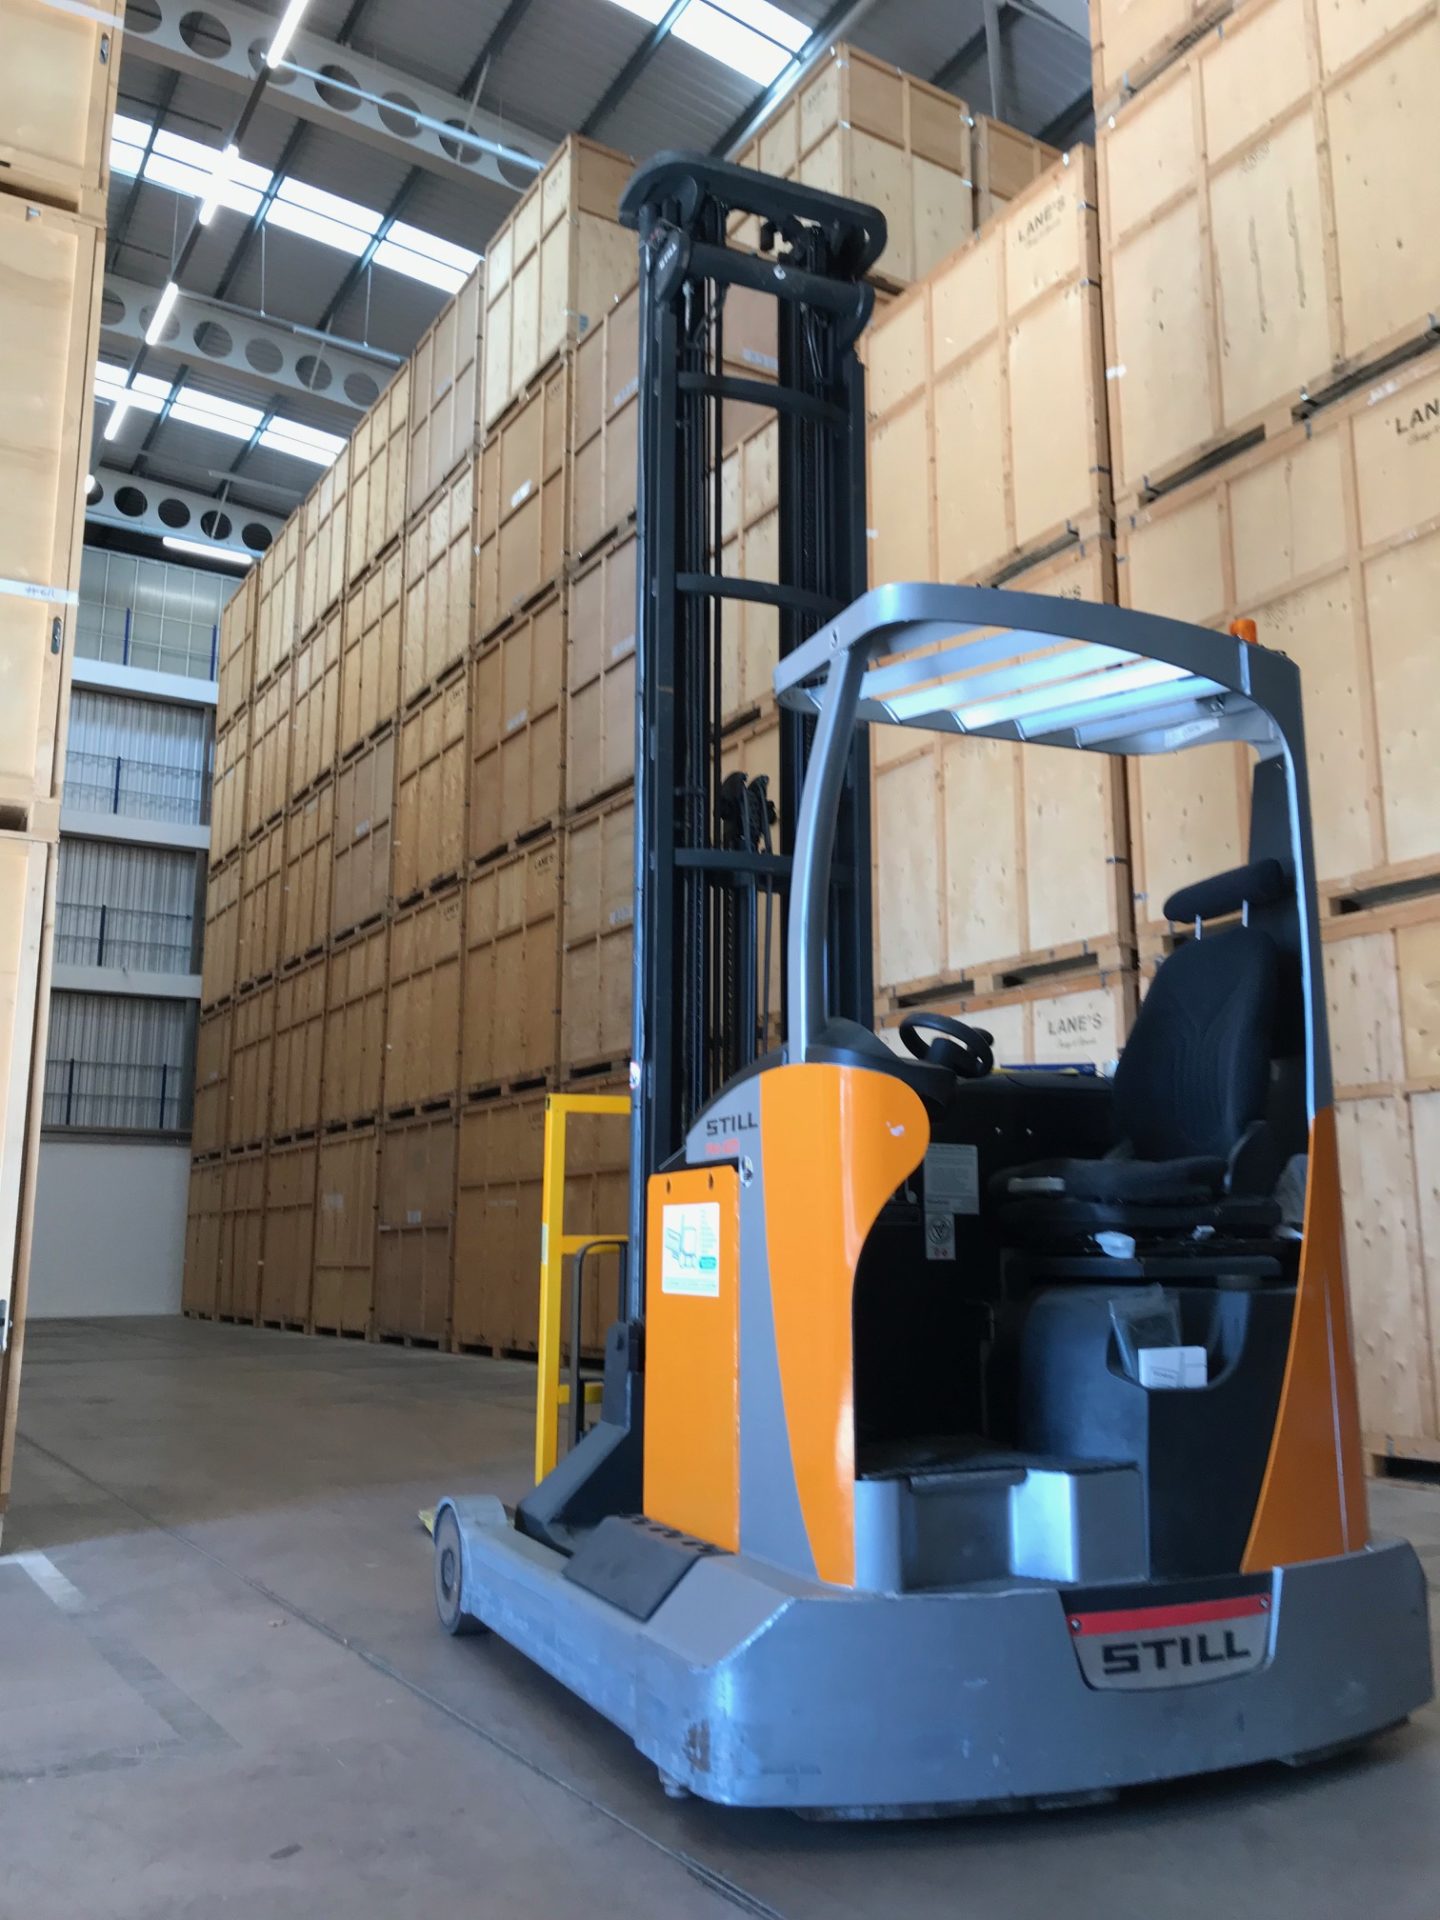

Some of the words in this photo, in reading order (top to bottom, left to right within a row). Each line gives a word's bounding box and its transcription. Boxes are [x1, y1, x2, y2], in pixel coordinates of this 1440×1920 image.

[1018, 195, 1065, 243] LANE'S
[1047, 1012, 1102, 1036] LANE'S
[706, 1112, 758, 1136] STILL
[1102, 1630, 1250, 1674] STILL
